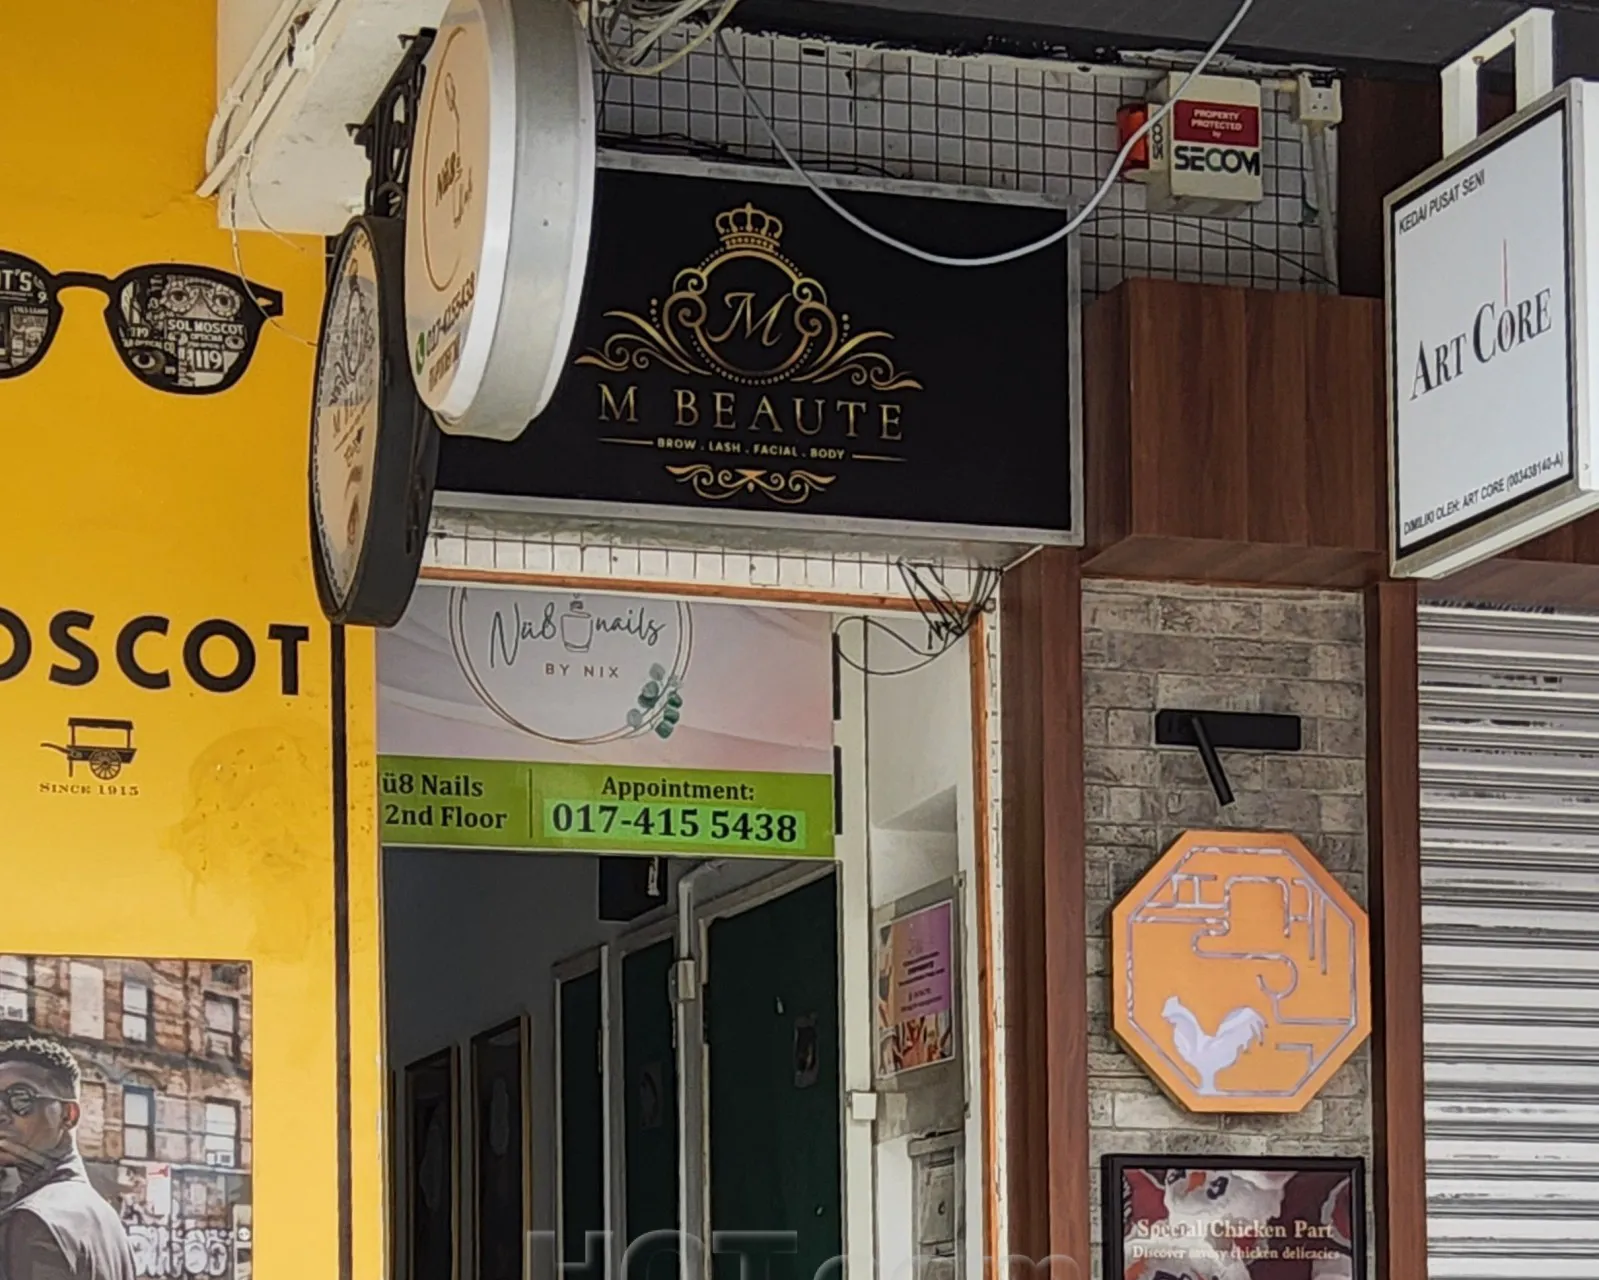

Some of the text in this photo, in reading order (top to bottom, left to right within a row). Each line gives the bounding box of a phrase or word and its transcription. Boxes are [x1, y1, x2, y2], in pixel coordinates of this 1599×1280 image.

[1190, 118, 1243, 131] PROTECTED
[1193, 108, 1240, 120] PROPERTY
[1174, 145, 1261, 177] SECOM
[1399, 168, 1486, 235] KEDAI PUSAT SENI
[167, 319, 244, 335] SOL MOSCOT
[706, 291, 792, 347] M
[597, 383, 903, 440] M BEAUTE
[657, 437, 845, 460] BROW LASH FACIAL BODY
[1462, 489, 1480, 510] ART
[1480, 477, 1505, 500] CORE
[595, 606, 666, 647] nails
[545, 663, 620, 679] BY NIX
[39, 781, 139, 797] SINCE 1915
[421, 774, 484, 797] Nails
[602, 776, 755, 801] Appointment:
[385, 803, 508, 829] 2nd Floor
[552, 803, 797, 843] 017-415 5438
[1137, 1218, 1334, 1241] Special Chicken Part
[1228, 1245, 1278, 1261] chicken
